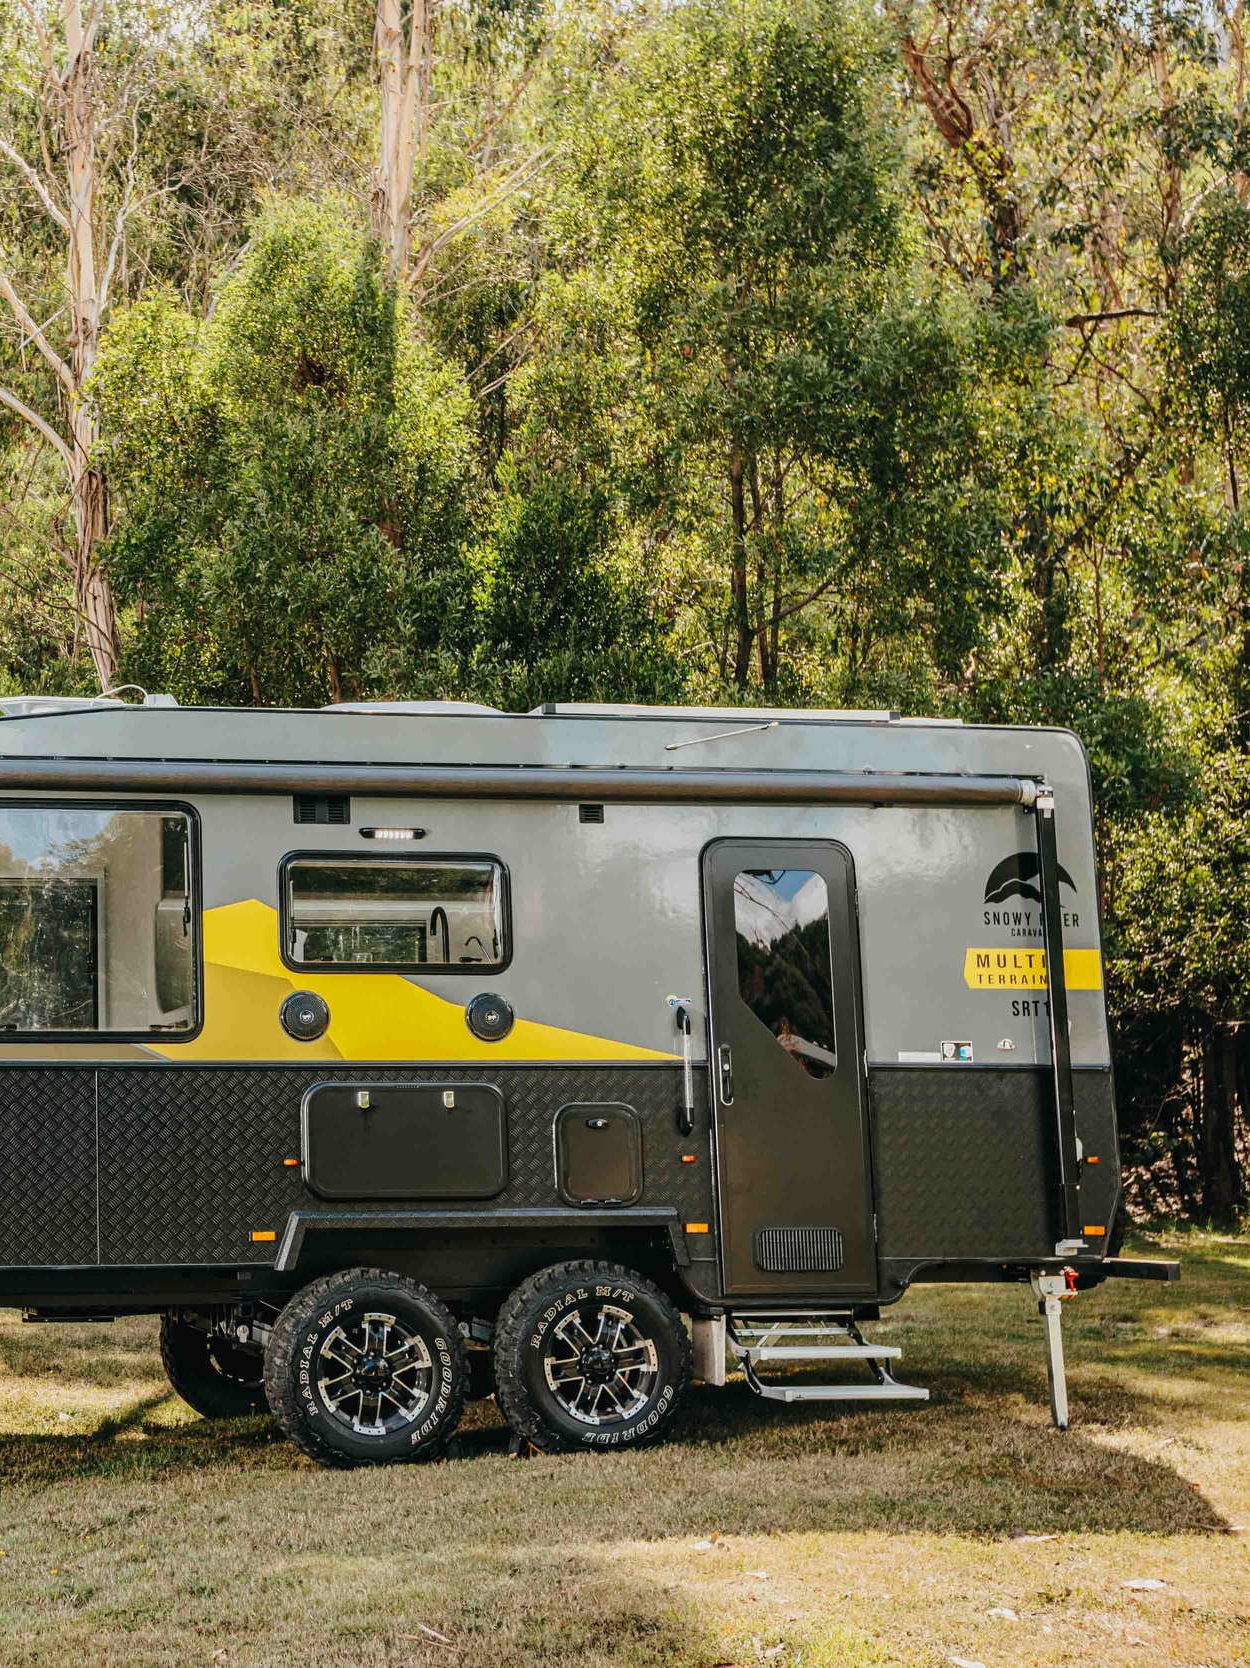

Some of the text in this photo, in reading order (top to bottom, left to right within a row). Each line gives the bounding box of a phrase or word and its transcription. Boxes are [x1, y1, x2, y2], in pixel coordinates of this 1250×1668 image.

[983, 911, 1032, 926] SNOWY
[1011, 928, 1043, 937] CARAVA
[976, 954, 1047, 969] MULTI
[977, 974, 1049, 985] TERRAIN
[530, 1286, 635, 1349] RADIAL M/T
[300, 1298, 354, 1416] RADIAL M/T
[410, 1337, 452, 1444] GOODRIDE
[582, 1385, 674, 1443] GOODRIDE
